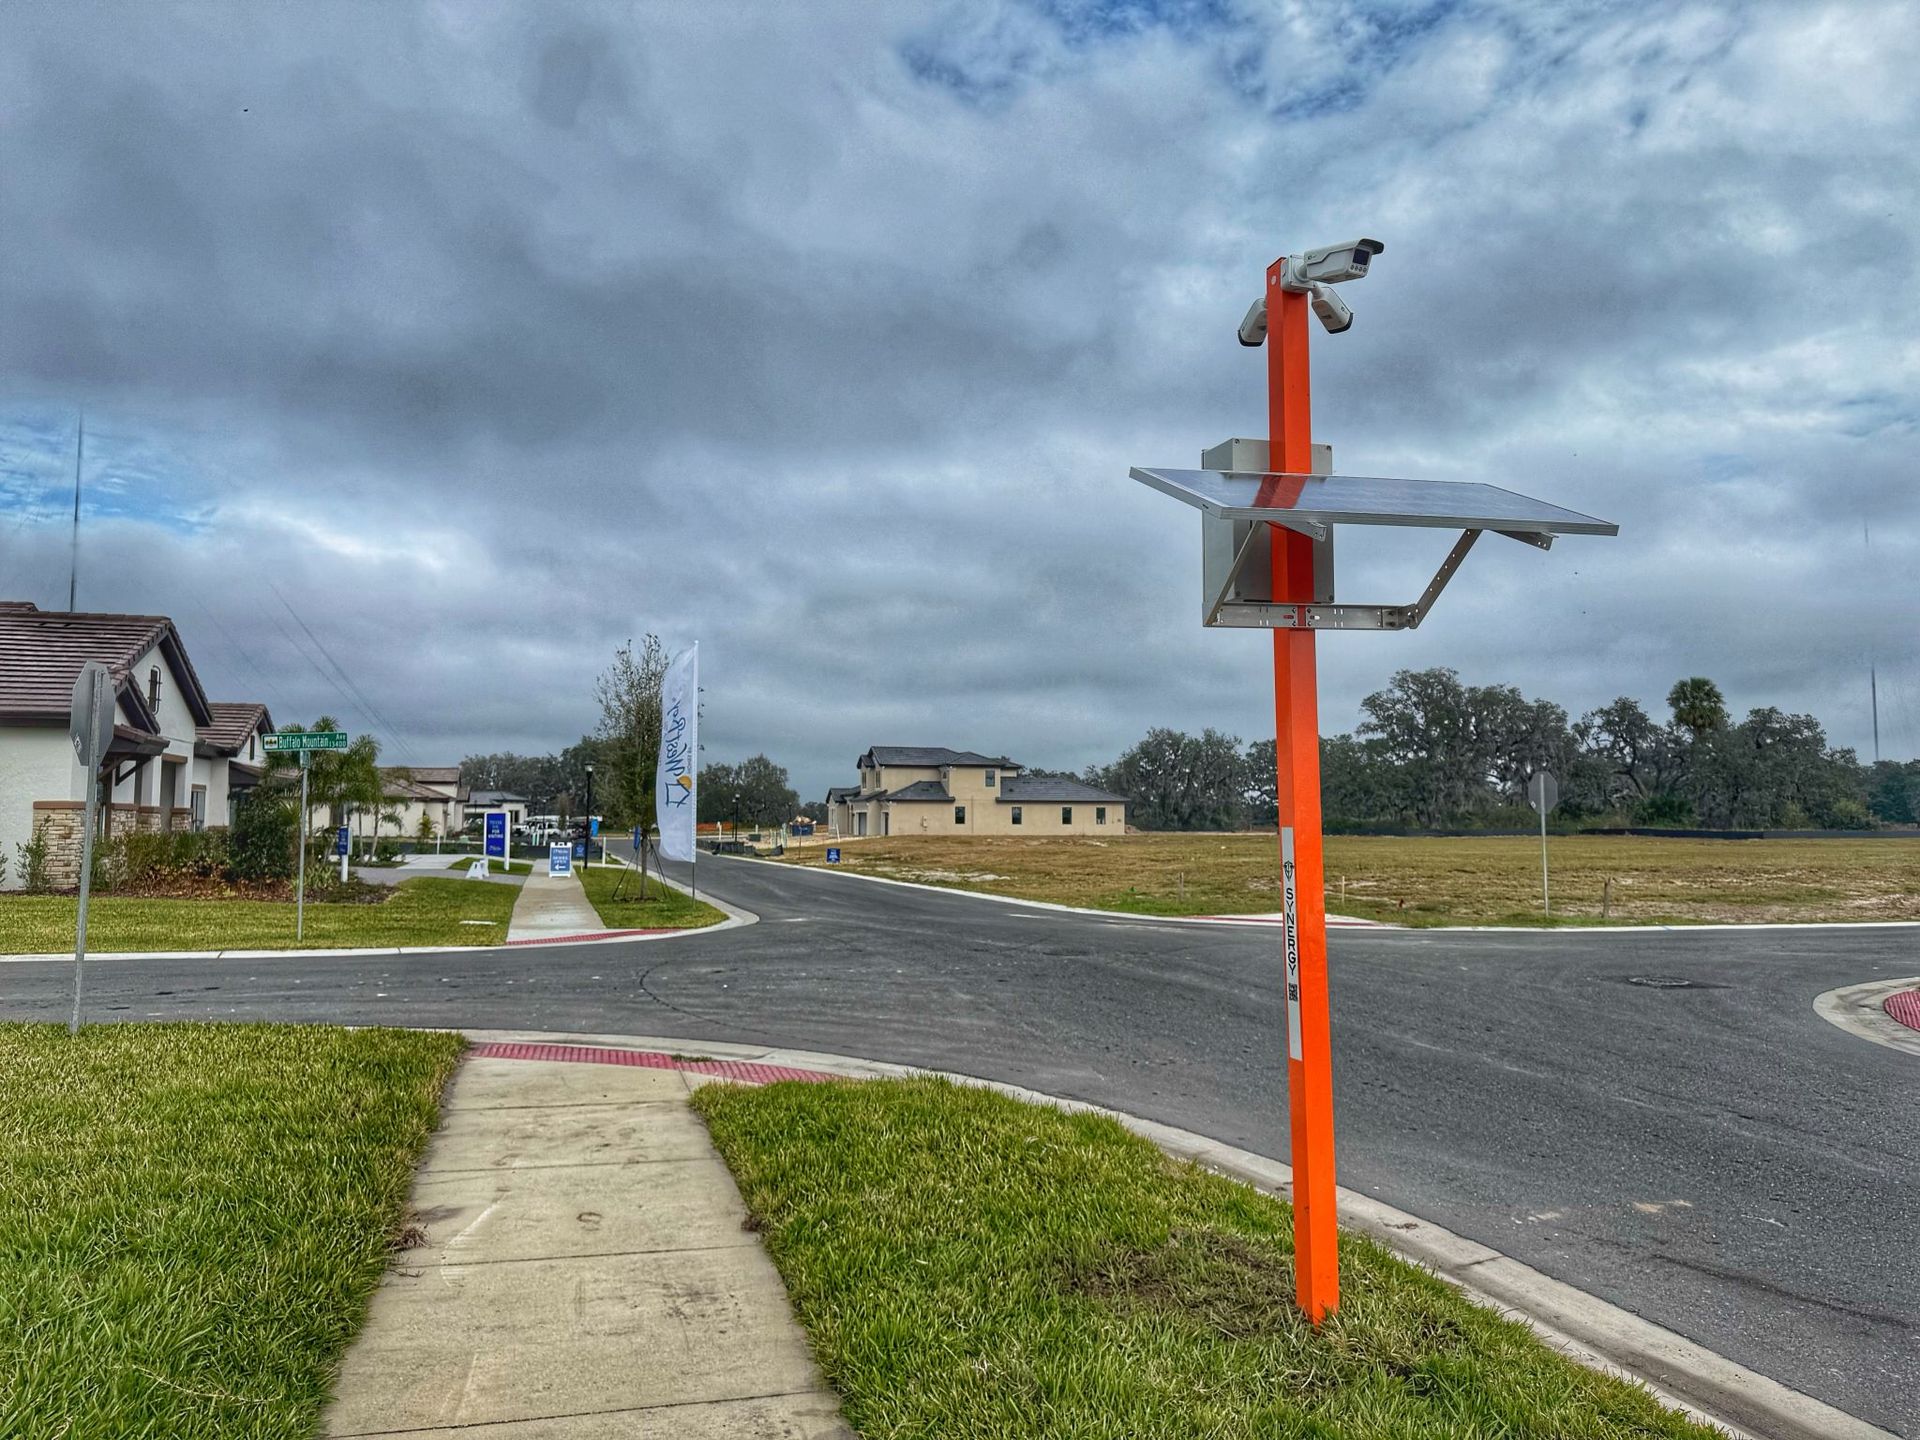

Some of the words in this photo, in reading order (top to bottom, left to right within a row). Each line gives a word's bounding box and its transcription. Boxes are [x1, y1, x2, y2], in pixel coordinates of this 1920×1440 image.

[279, 736, 300, 748] Buffalo
[302, 735, 329, 748] Mountain
[1286, 888, 1296, 976] SYNERGY
